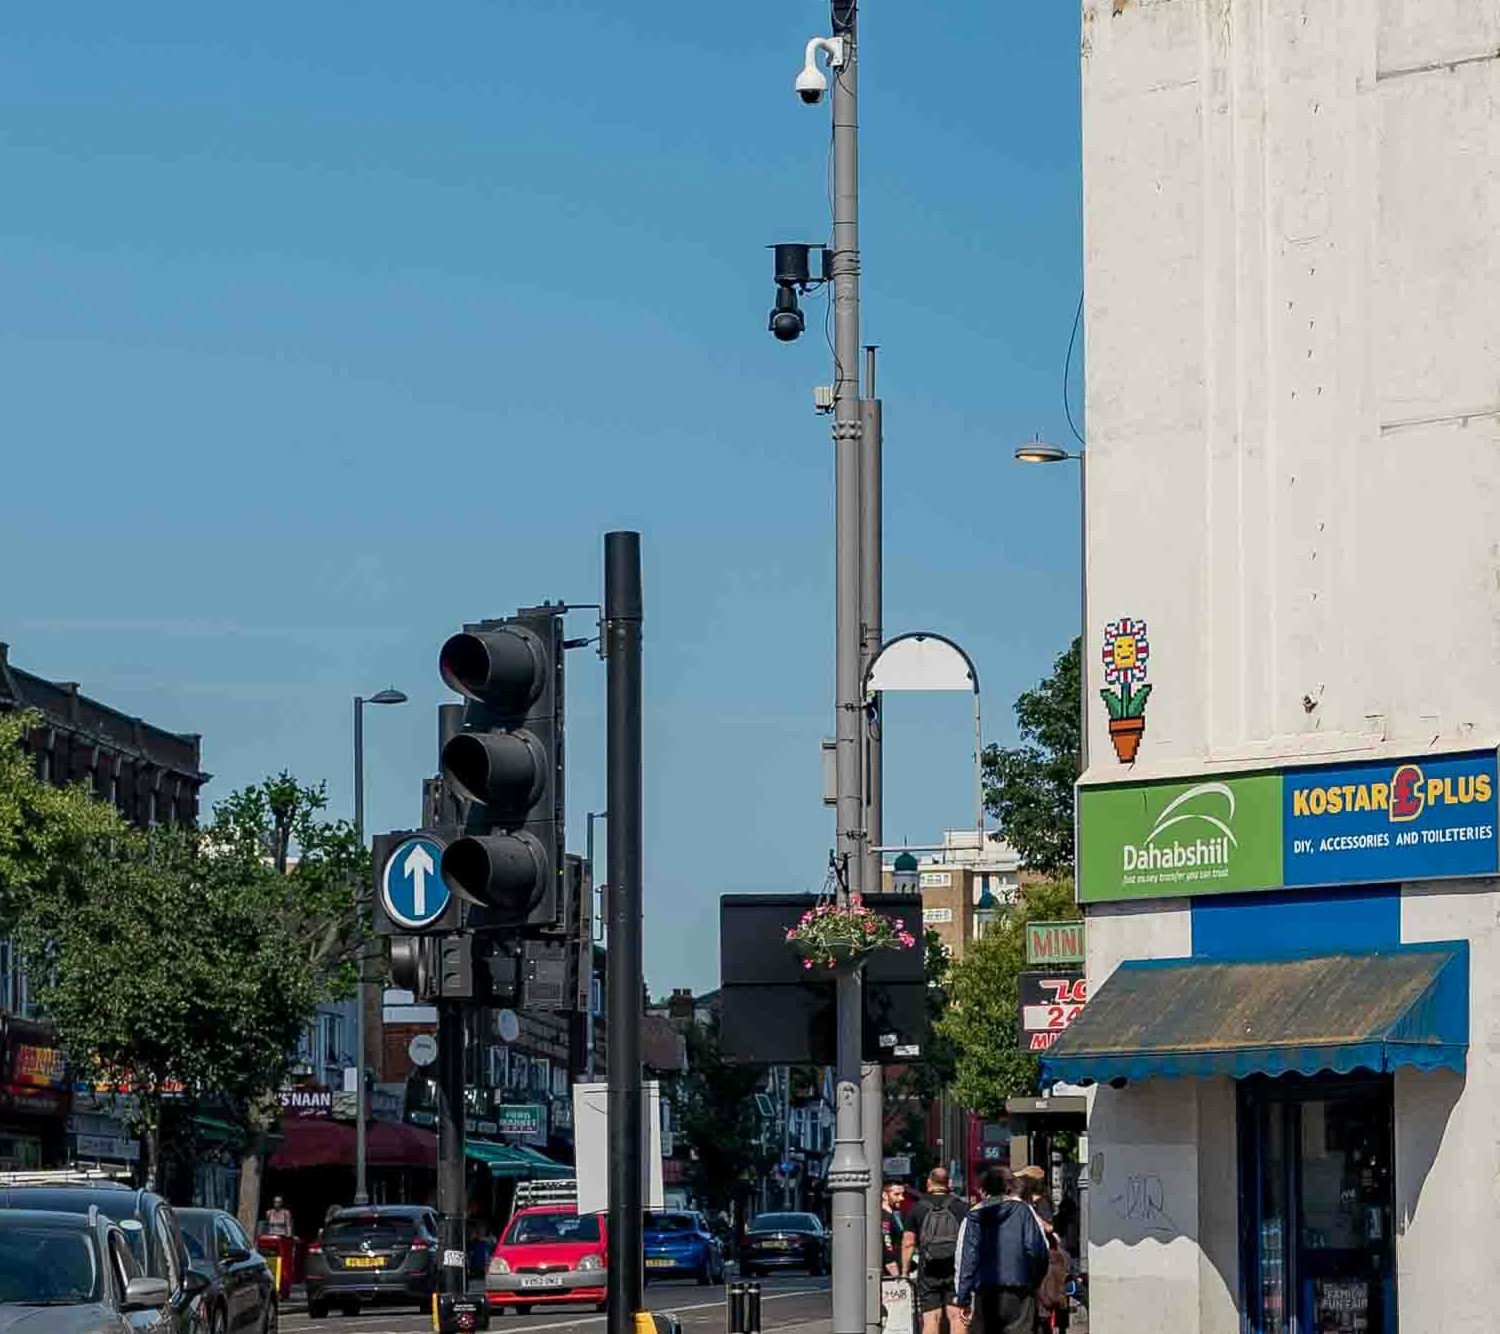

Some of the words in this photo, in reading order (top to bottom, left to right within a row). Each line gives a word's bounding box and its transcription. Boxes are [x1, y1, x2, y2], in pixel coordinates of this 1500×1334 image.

[1293, 782, 1389, 817] KOSTAR
[1427, 774, 1492, 806] PLUS
[1294, 840, 1314, 854] DIY,
[1320, 833, 1389, 852] ACCESSORIES
[1396, 831, 1419, 846] AND
[1421, 825, 1492, 844] TOILETERIES
[1124, 837, 1228, 871] Dahabshiil
[1032, 928, 1083, 956] MINI
[292, 1091, 331, 1107] NAAN
[1328, 1289, 1365, 1299] FAMILY
